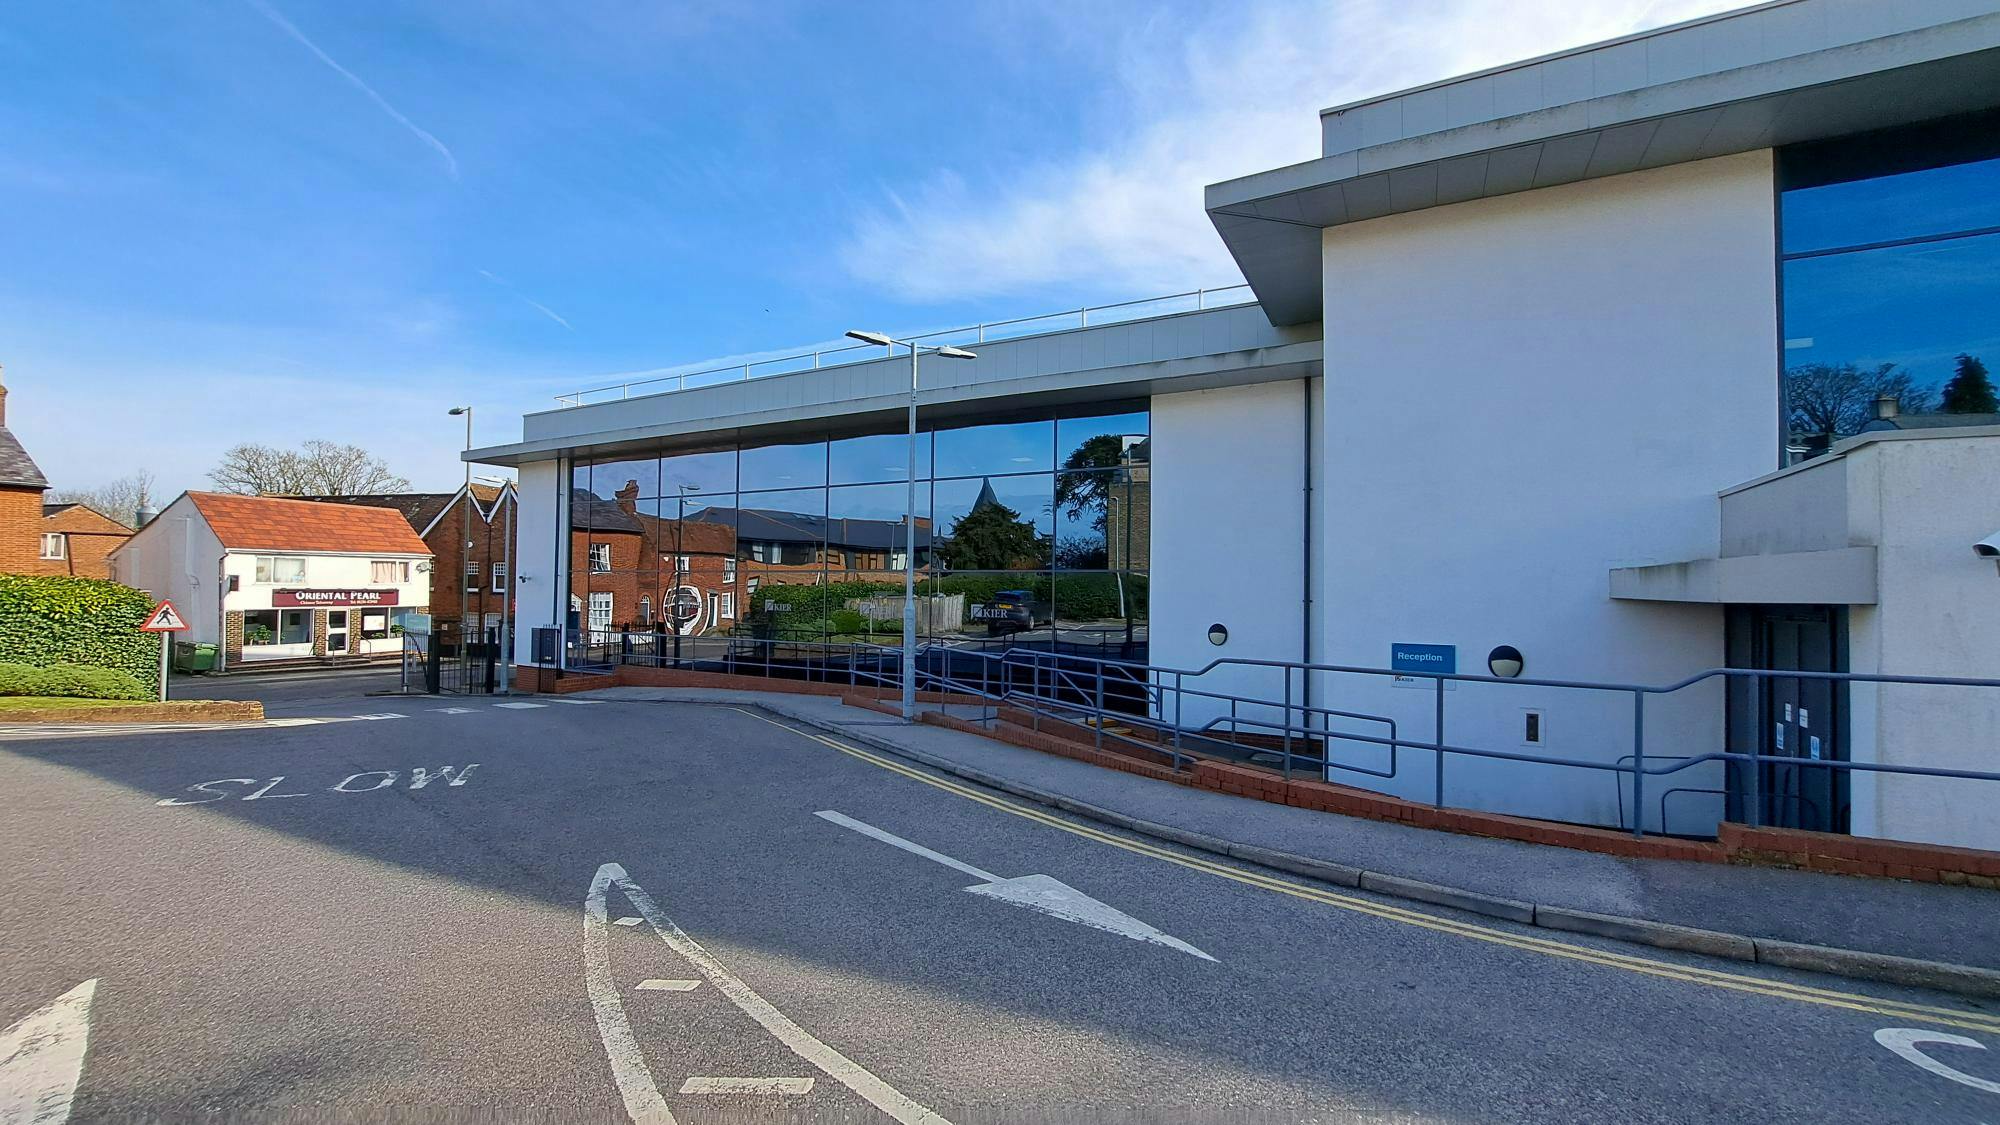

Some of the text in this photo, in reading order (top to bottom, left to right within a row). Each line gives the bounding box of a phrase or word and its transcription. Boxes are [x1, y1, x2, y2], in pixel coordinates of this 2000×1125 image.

[295, 591, 381, 600] ORIENTAL PEARL
[774, 603, 792, 611] KIER
[983, 608, 1008, 618] KIER
[1397, 652, 1443, 662] Reception
[156, 763, 480, 807] SLOW
